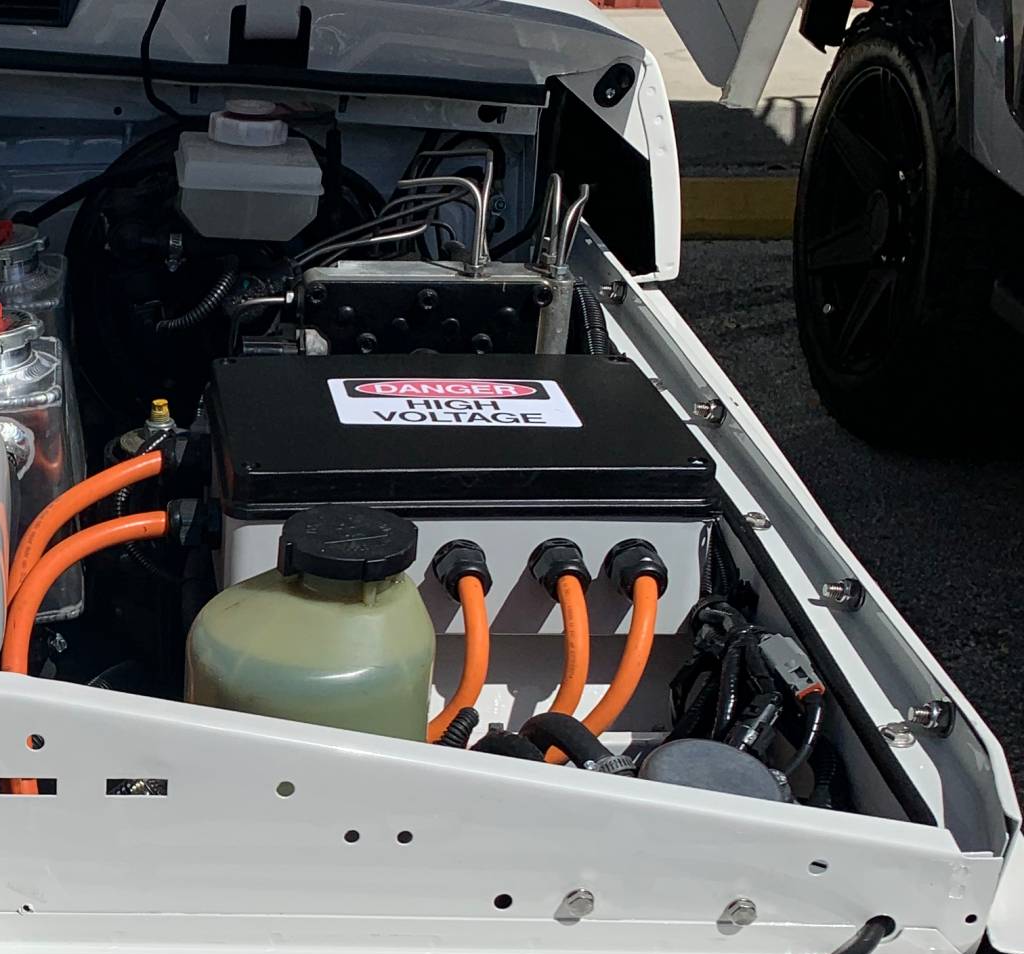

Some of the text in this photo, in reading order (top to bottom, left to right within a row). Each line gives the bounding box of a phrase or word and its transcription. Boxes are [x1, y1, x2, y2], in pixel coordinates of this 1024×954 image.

[375, 383, 519, 396] DANGER
[406, 399, 501, 411] HIGH
[373, 410, 547, 424] VOLTAGE
